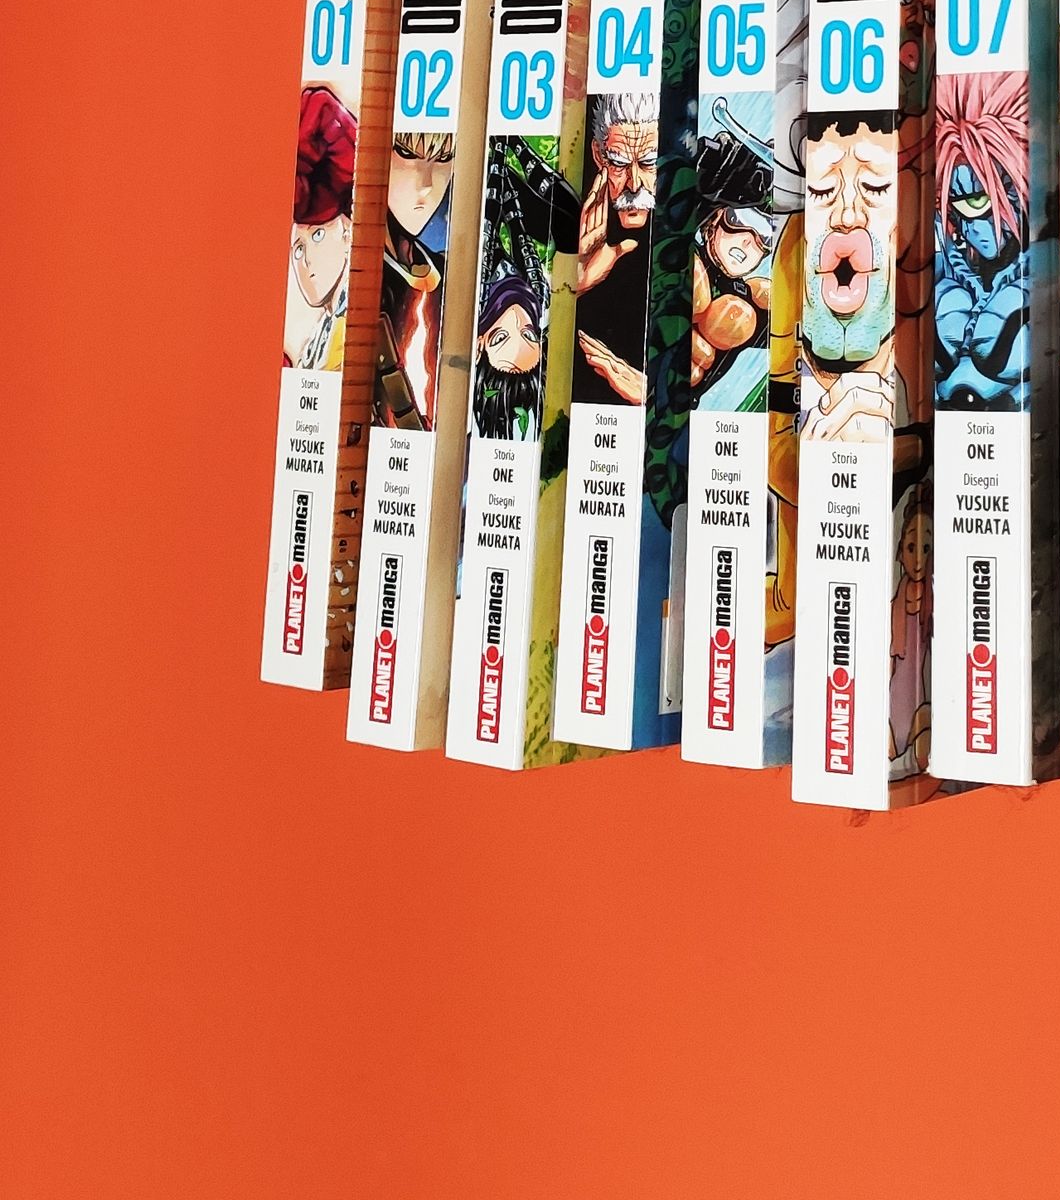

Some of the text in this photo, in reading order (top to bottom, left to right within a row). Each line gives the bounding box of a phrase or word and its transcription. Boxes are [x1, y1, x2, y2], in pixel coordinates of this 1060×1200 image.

[312, 0, 352, 66] 01
[708, 3, 765, 77] 05
[597, 7, 653, 78] 04
[821, 18, 884, 94] 06
[401, 50, 453, 117] 02
[500, 50, 555, 120] 03
[302, 378, 319, 389] Storia
[300, 396, 318, 410] ONE
[296, 421, 319, 435] Disegni
[596, 414, 617, 426] Storia
[716, 421, 739, 433] Storia
[967, 422, 994, 434] Storia
[290, 438, 325, 455] YUSUKE
[390, 438, 410, 449] Storia
[594, 433, 616, 449] ONE
[715, 441, 738, 457] ONE
[494, 449, 514, 461] Storia
[832, 452, 857, 464] Storia
[967, 444, 994, 460] ONE
[286, 457, 323, 474] MURATA
[389, 457, 408, 471] ONE
[590, 460, 618, 476] Disegni
[493, 468, 513, 483] ONE
[712, 469, 740, 484] Disegni
[832, 473, 857, 488] ONE
[964, 473, 998, 489] Disegni
[384, 481, 409, 497] Disegni
[584, 479, 625, 497] YUSUKE
[489, 494, 515, 509] Disegni
[705, 489, 749, 506] YUSUKE
[956, 495, 1009, 512] YUSUKE
[377, 500, 416, 518] YUSUKE
[579, 500, 625, 517] MURATA
[828, 501, 860, 517] Disegni
[482, 512, 521, 530] YUSUKE
[701, 510, 750, 527] MURATA
[953, 517, 1010, 535] MURATA
[373, 519, 415, 537] MURATA
[820, 522, 869, 540] YUSUKE
[477, 532, 520, 550] MURATA
[816, 544, 870, 562] MURATA
[285, 583, 304, 654] PLANET
[585, 637, 605, 712] PLANET
[372, 649, 393, 722] PLANET
[712, 650, 732, 729] PLANET
[480, 668, 499, 742] PLANET
[972, 667, 992, 750] PLANET
[830, 690, 850, 772] PLANET
